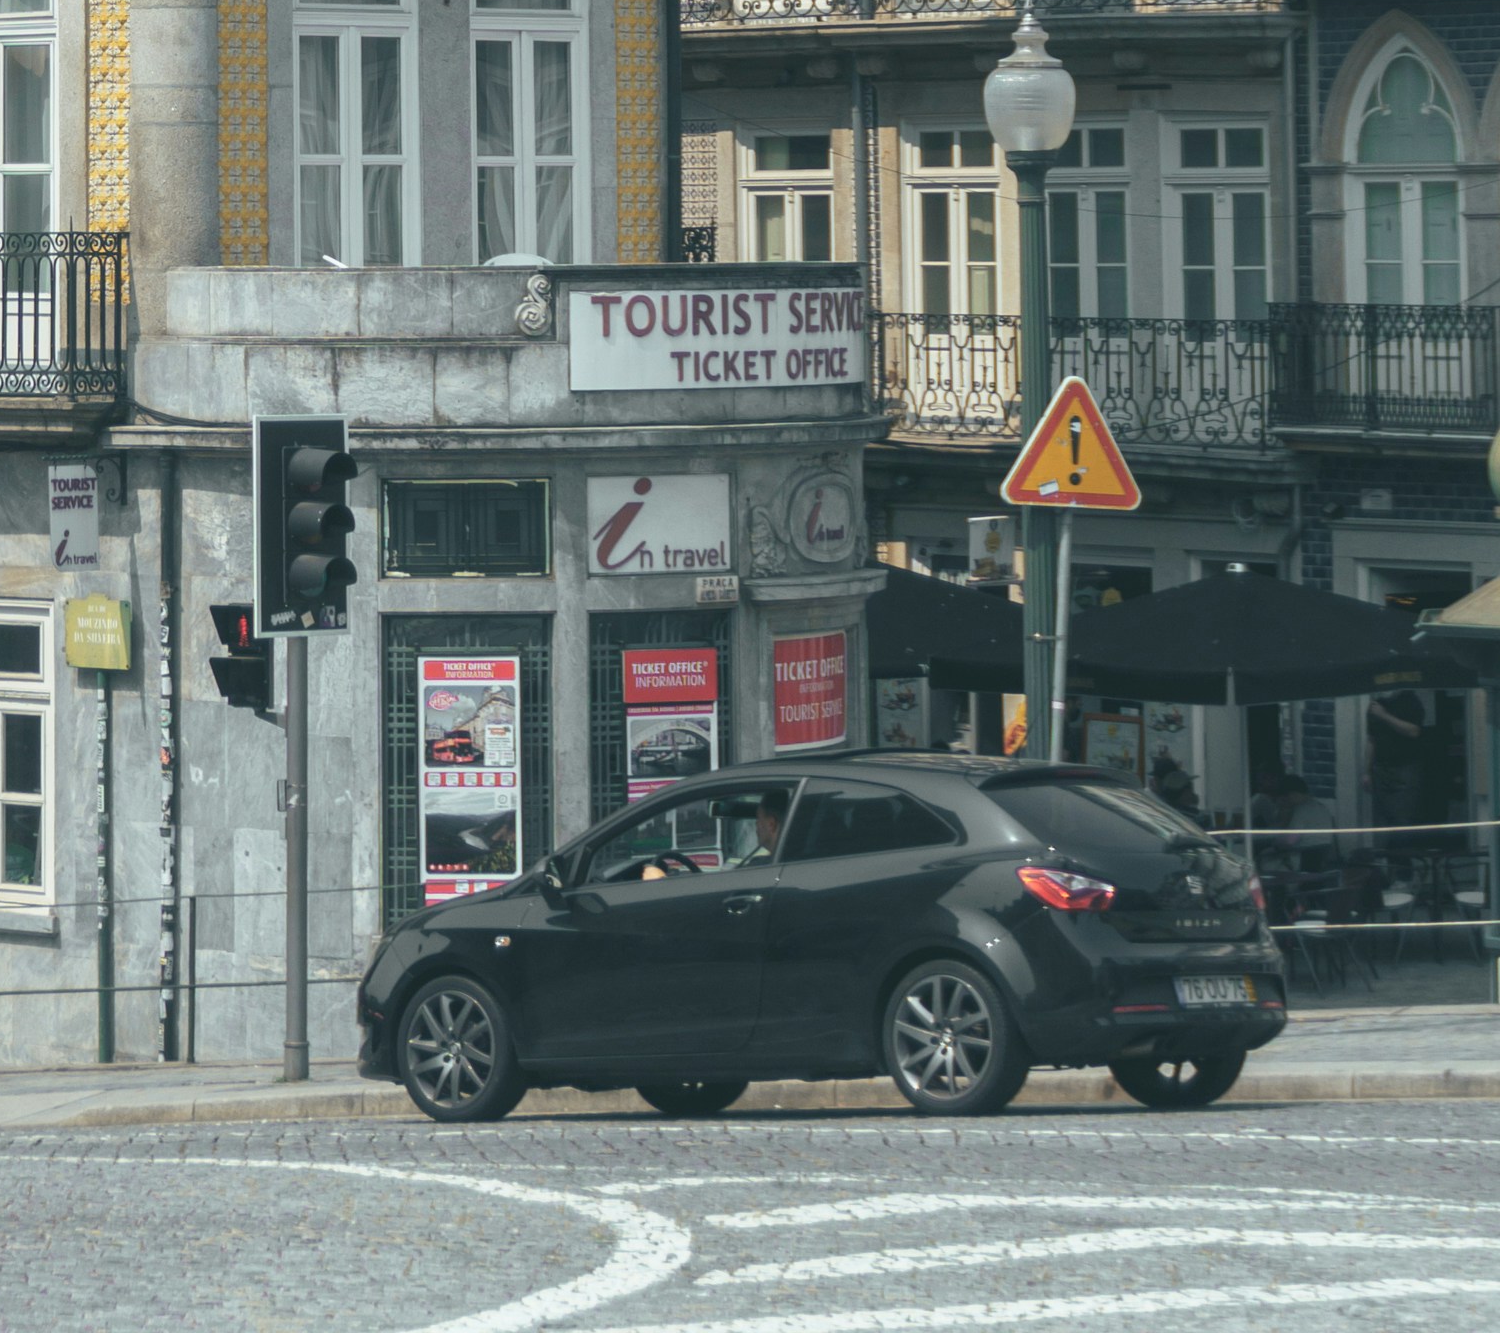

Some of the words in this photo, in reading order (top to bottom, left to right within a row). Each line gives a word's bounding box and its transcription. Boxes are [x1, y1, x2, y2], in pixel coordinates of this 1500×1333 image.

[591, 293, 776, 337] TOURIST
[789, 290, 865, 333] SERVICE
[670, 349, 777, 382] TICKET
[786, 347, 848, 380] OFFICE
[51, 477, 98, 493] TOURIST
[51, 494, 94, 511] SERVICE
[73, 552, 98, 565] travel
[663, 541, 727, 569] travel
[77, 617, 118, 630] MOUZINHO
[74, 631, 84, 643] DA
[87, 632, 121, 645] SILVEIRA
[443, 662, 467, 671] TICKET
[631, 663, 666, 674] TICKET
[775, 660, 818, 682] TICKET
[820, 655, 844, 677] OFFICE
[445, 671, 494, 679] INFORMATION
[635, 674, 706, 688] INFORMATION
[779, 702, 820, 723] TOURIST
[821, 698, 842, 718] SERVICE
